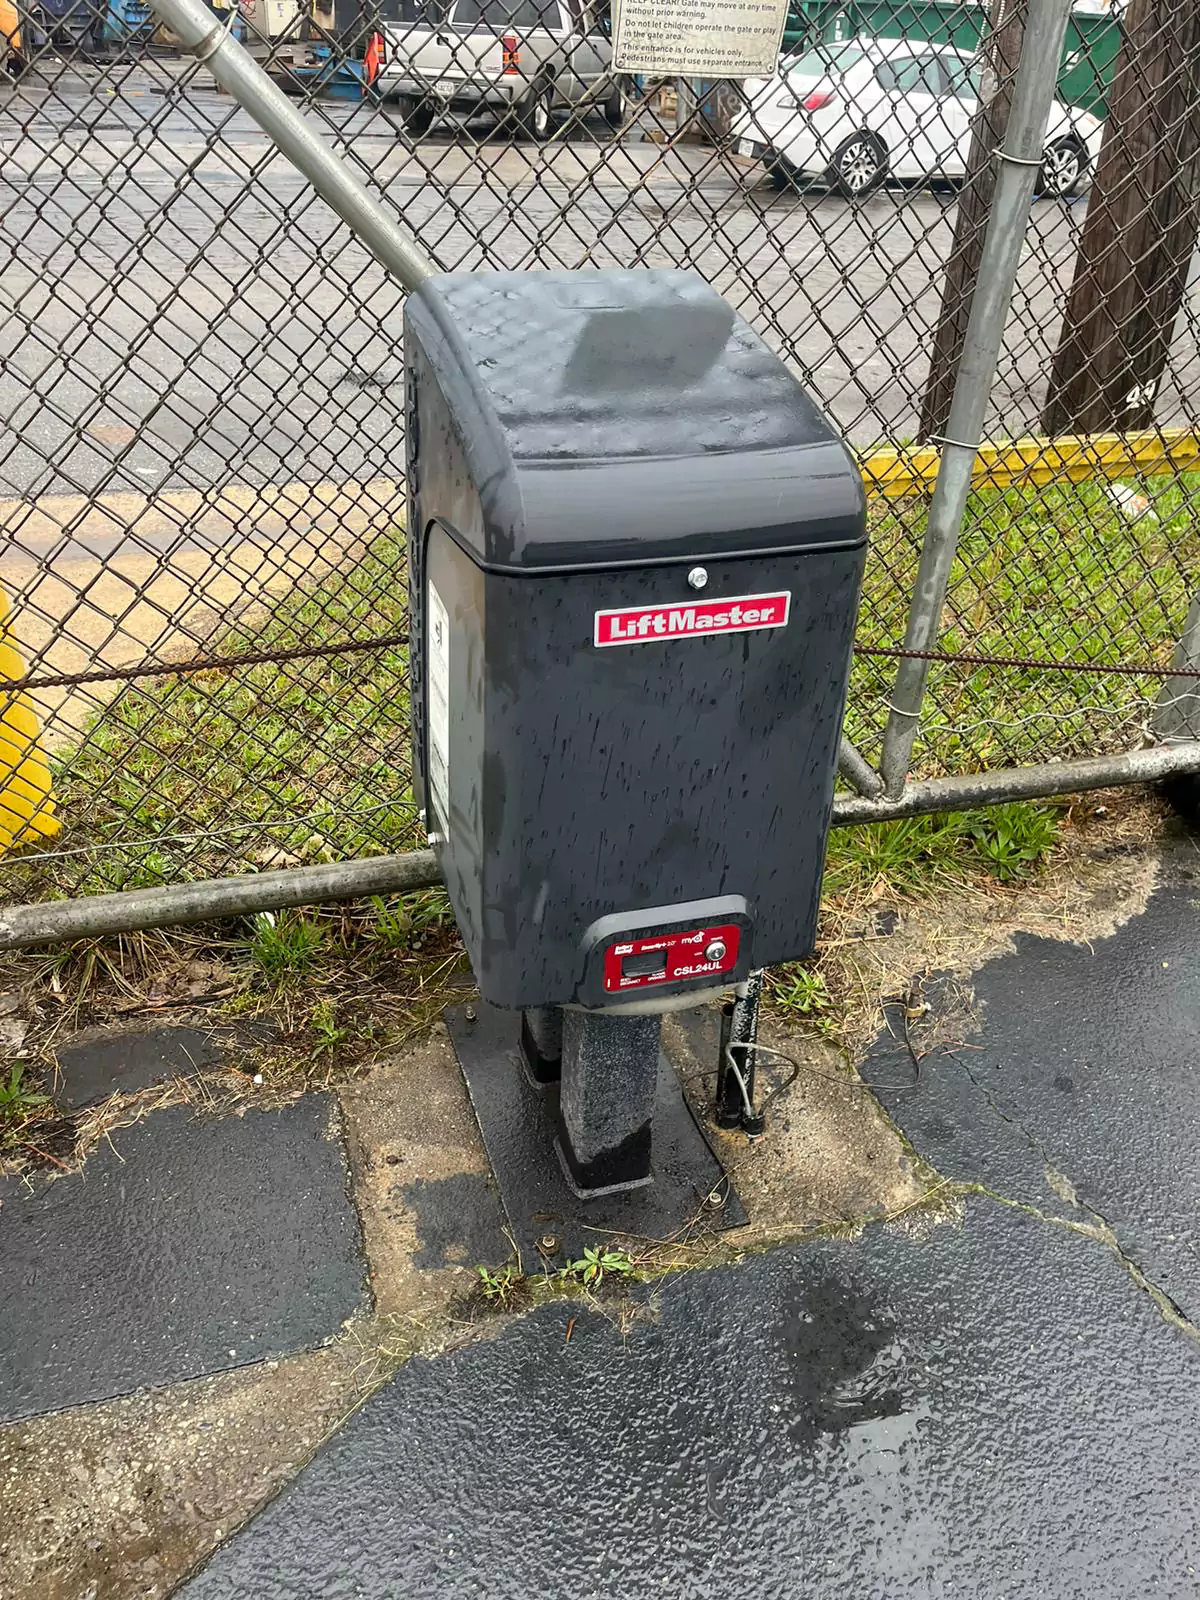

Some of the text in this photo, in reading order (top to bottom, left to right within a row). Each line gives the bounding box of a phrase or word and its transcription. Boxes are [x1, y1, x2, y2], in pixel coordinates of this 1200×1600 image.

[626, 7, 654, 15] without
[656, 9, 674, 18] prior
[700, 1, 716, 9] may
[747, 4, 760, 12] any
[625, 19, 636, 27] Do
[664, 21, 694, 30] children
[695, 24, 722, 33] operate
[737, 26, 752, 34] gate
[763, 26, 777, 35] play
[633, 30, 645, 38] the
[647, 31, 663, 40] gate
[623, 42, 640, 50] This
[641, 44, 673, 53] entrance
[727, 49, 743, 57] only.
[621, 53, 666, 63] Pedestrians
[703, 58, 733, 67] separate
[610, 605, 775, 639] LiftMaster
[673, 961, 723, 976] CSL24UL
